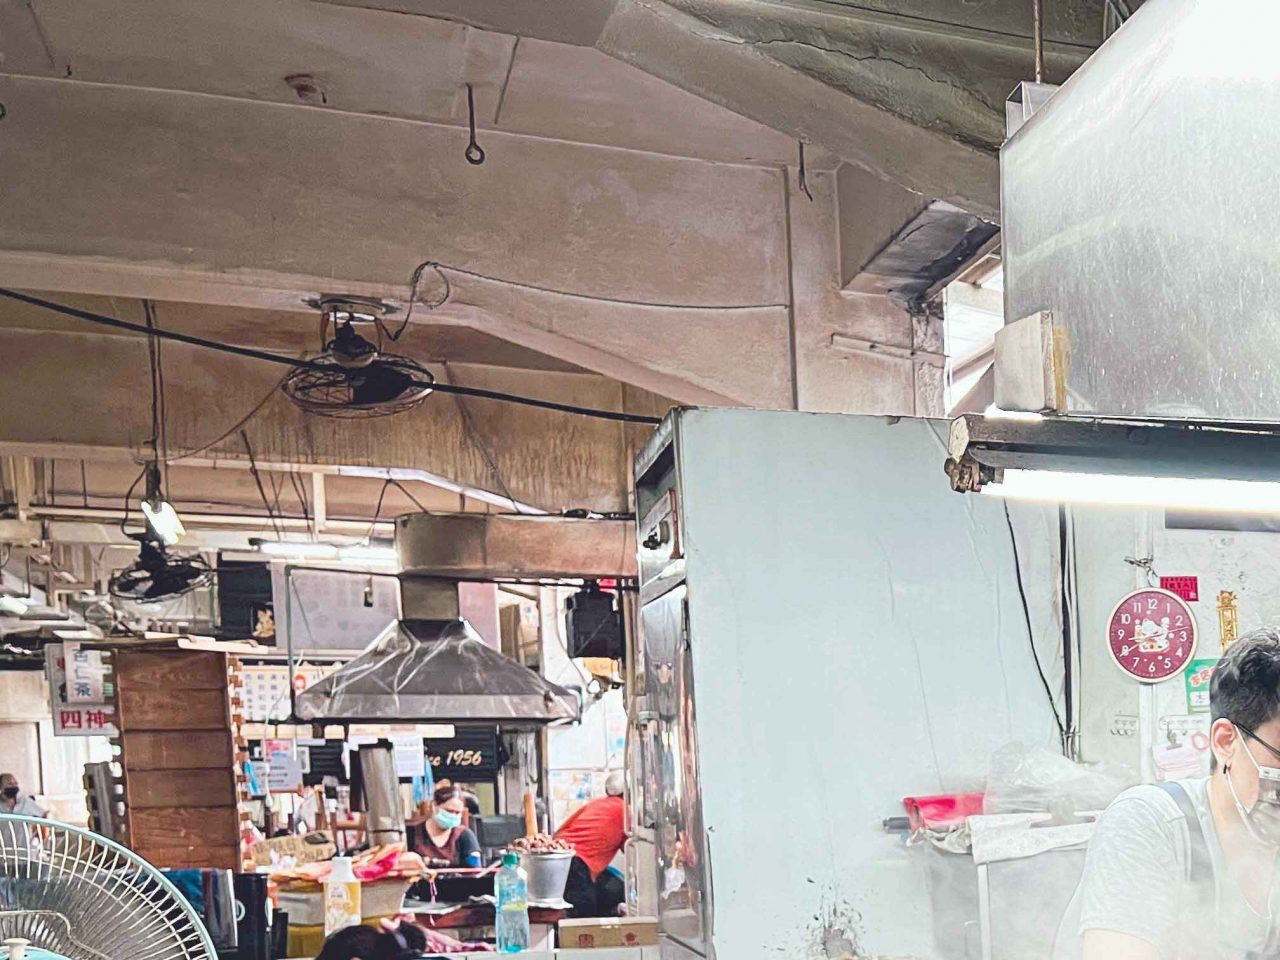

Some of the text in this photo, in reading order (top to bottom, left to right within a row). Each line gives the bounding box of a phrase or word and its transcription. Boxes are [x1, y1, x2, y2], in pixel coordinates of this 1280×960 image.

[1134, 602, 1141, 613] 11
[1148, 598, 1157, 609] 12
[1166, 602, 1171, 613] 1
[1121, 614, 1131, 624] 10
[1175, 615, 1183, 626] 2
[1118, 629, 1125, 639] 9
[1180, 631, 1187, 642] 3
[1175, 647, 1183, 658] 4
[1133, 657, 1140, 667] 7
[1148, 661, 1156, 672] 6
[1164, 657, 1171, 668] 5
[446, 749, 482, 766] 1956
